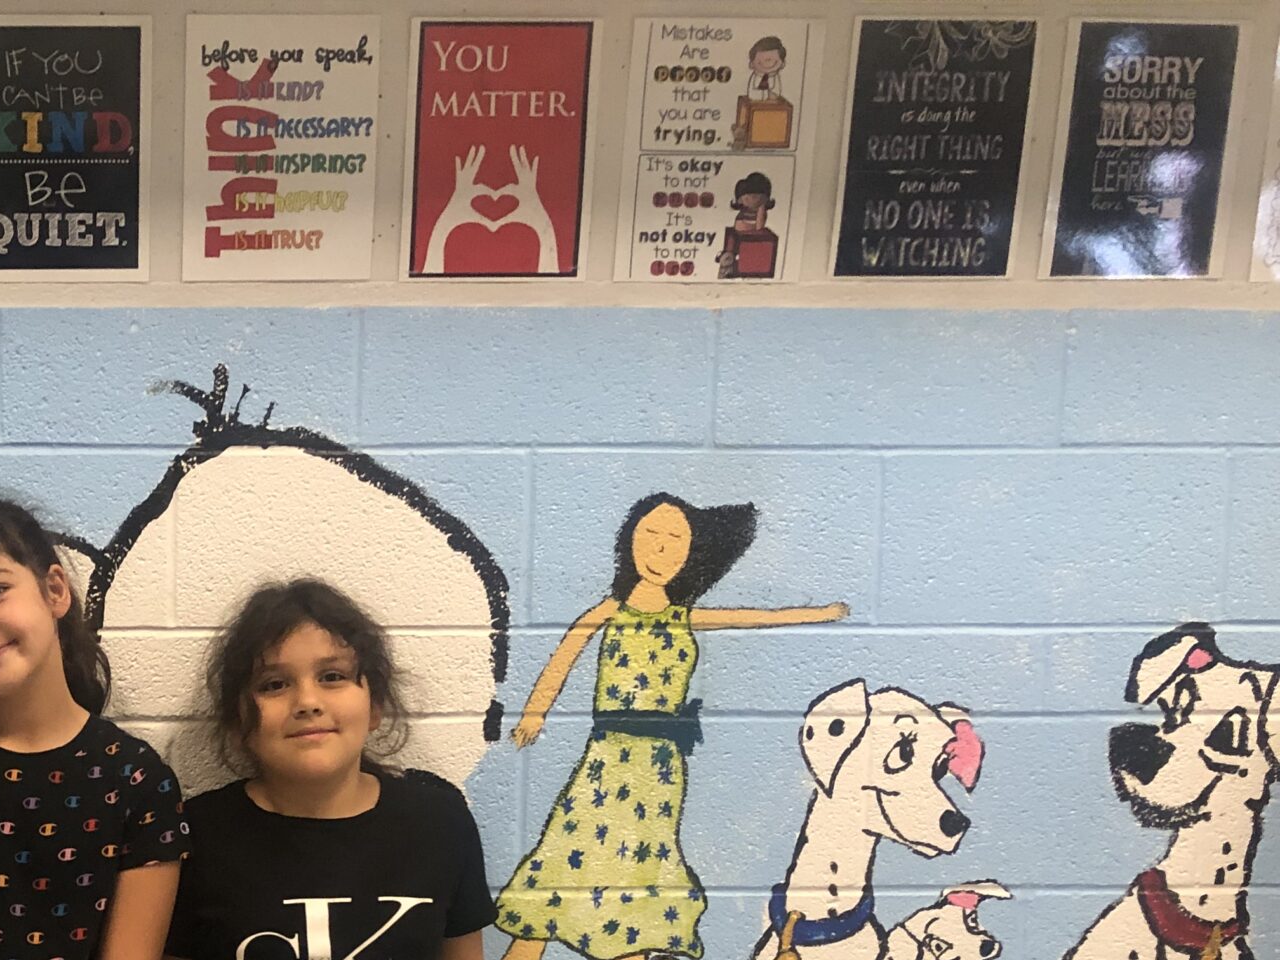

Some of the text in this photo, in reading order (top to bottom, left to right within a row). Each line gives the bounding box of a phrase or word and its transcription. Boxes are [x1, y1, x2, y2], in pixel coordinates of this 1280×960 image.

[661, 23, 734, 42] Mistakes
[4, 47, 103, 78] IF YOU
[201, 35, 373, 73] before you speak,
[433, 40, 509, 73] YOU
[680, 44, 710, 60] Are
[1103, 55, 1205, 84] SORRY
[672, 87, 711, 103] that
[873, 70, 1011, 103] INTEGRITY
[1103, 83, 1197, 100] about the
[429, 90, 576, 117] MATTER.
[658, 107, 721, 124] you are
[901, 106, 976, 133] is doing the
[1096, 101, 1197, 147] MESS
[653, 124, 722, 145] trying.
[867, 134, 1004, 161] RIGHT THING
[646, 157, 724, 176] It's okay
[1091, 159, 1194, 193] LEARG
[24, 170, 87, 208] Be
[663, 175, 710, 188] to not
[899, 177, 961, 194] even when
[665, 212, 693, 227] It's
[863, 199, 992, 231] NO ONE IS
[639, 229, 717, 247] not okay
[654, 246, 699, 259] to not
[861, 236, 986, 268] WATCHING
